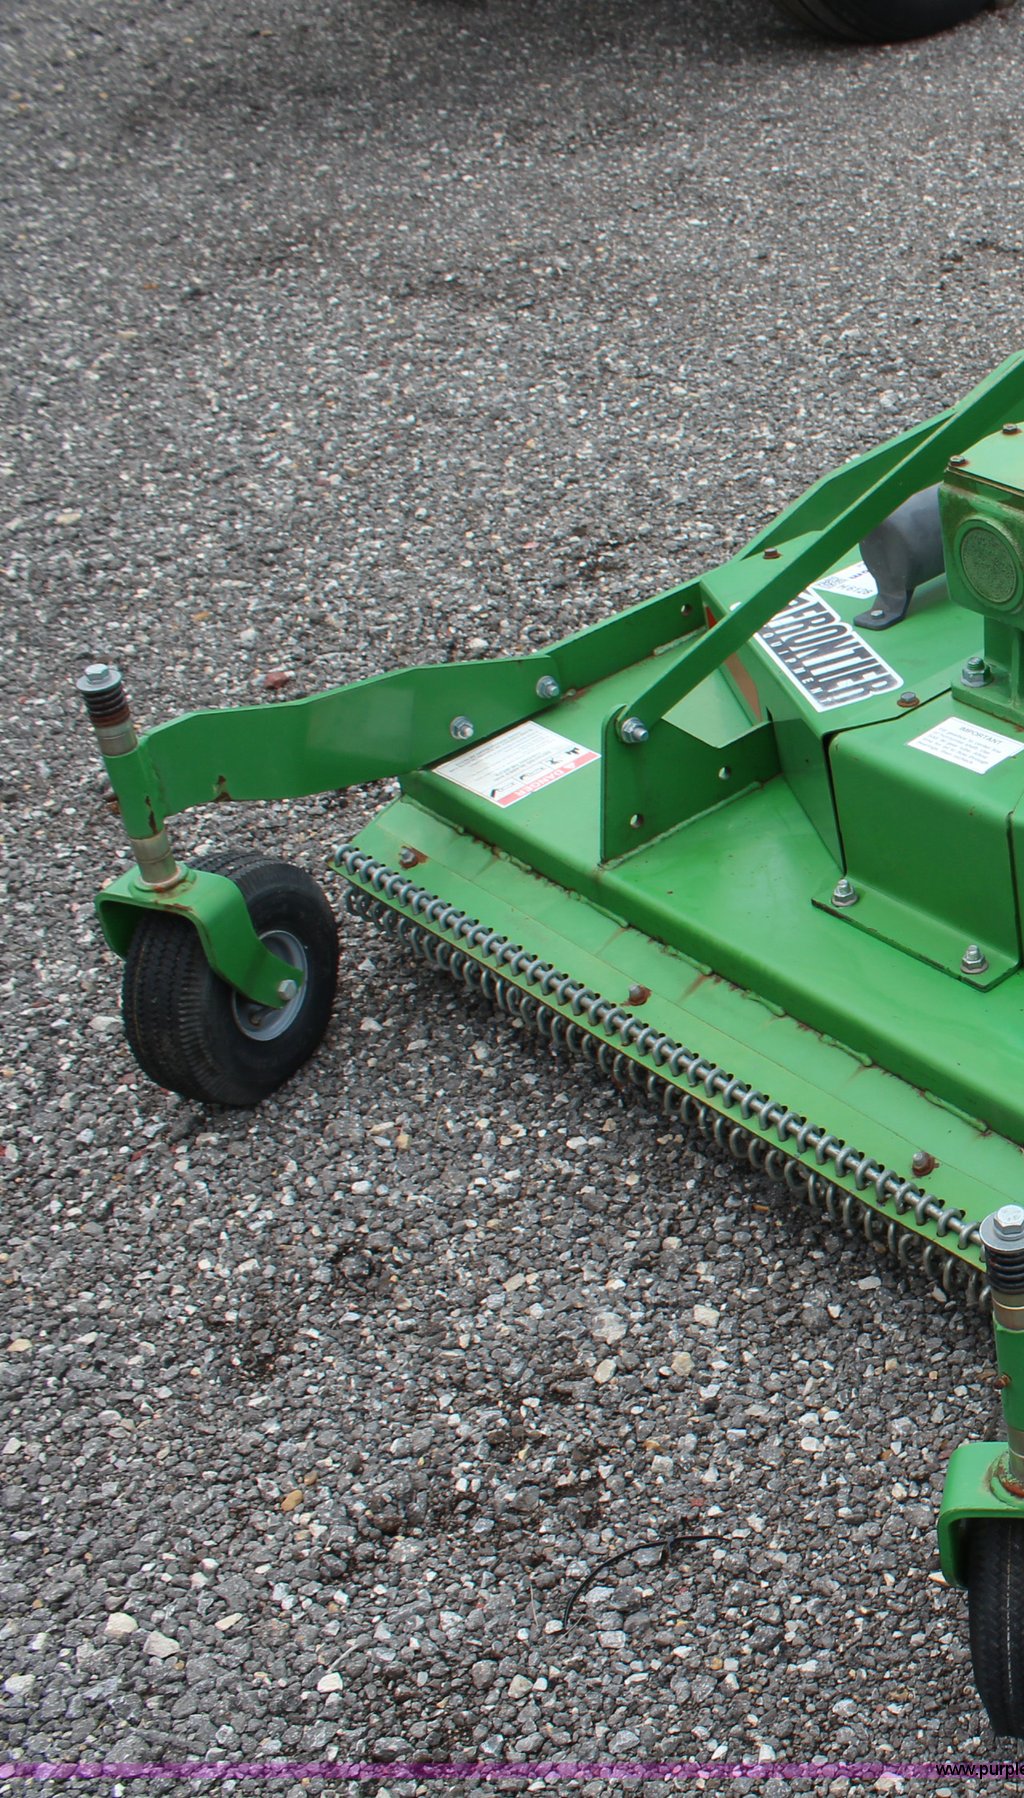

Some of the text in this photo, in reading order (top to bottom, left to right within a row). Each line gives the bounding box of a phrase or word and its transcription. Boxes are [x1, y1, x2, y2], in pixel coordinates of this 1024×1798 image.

[762, 624, 833, 704] QUIPMENT
[766, 601, 899, 700] FRONTIER
[514, 769, 565, 797] DANGER
